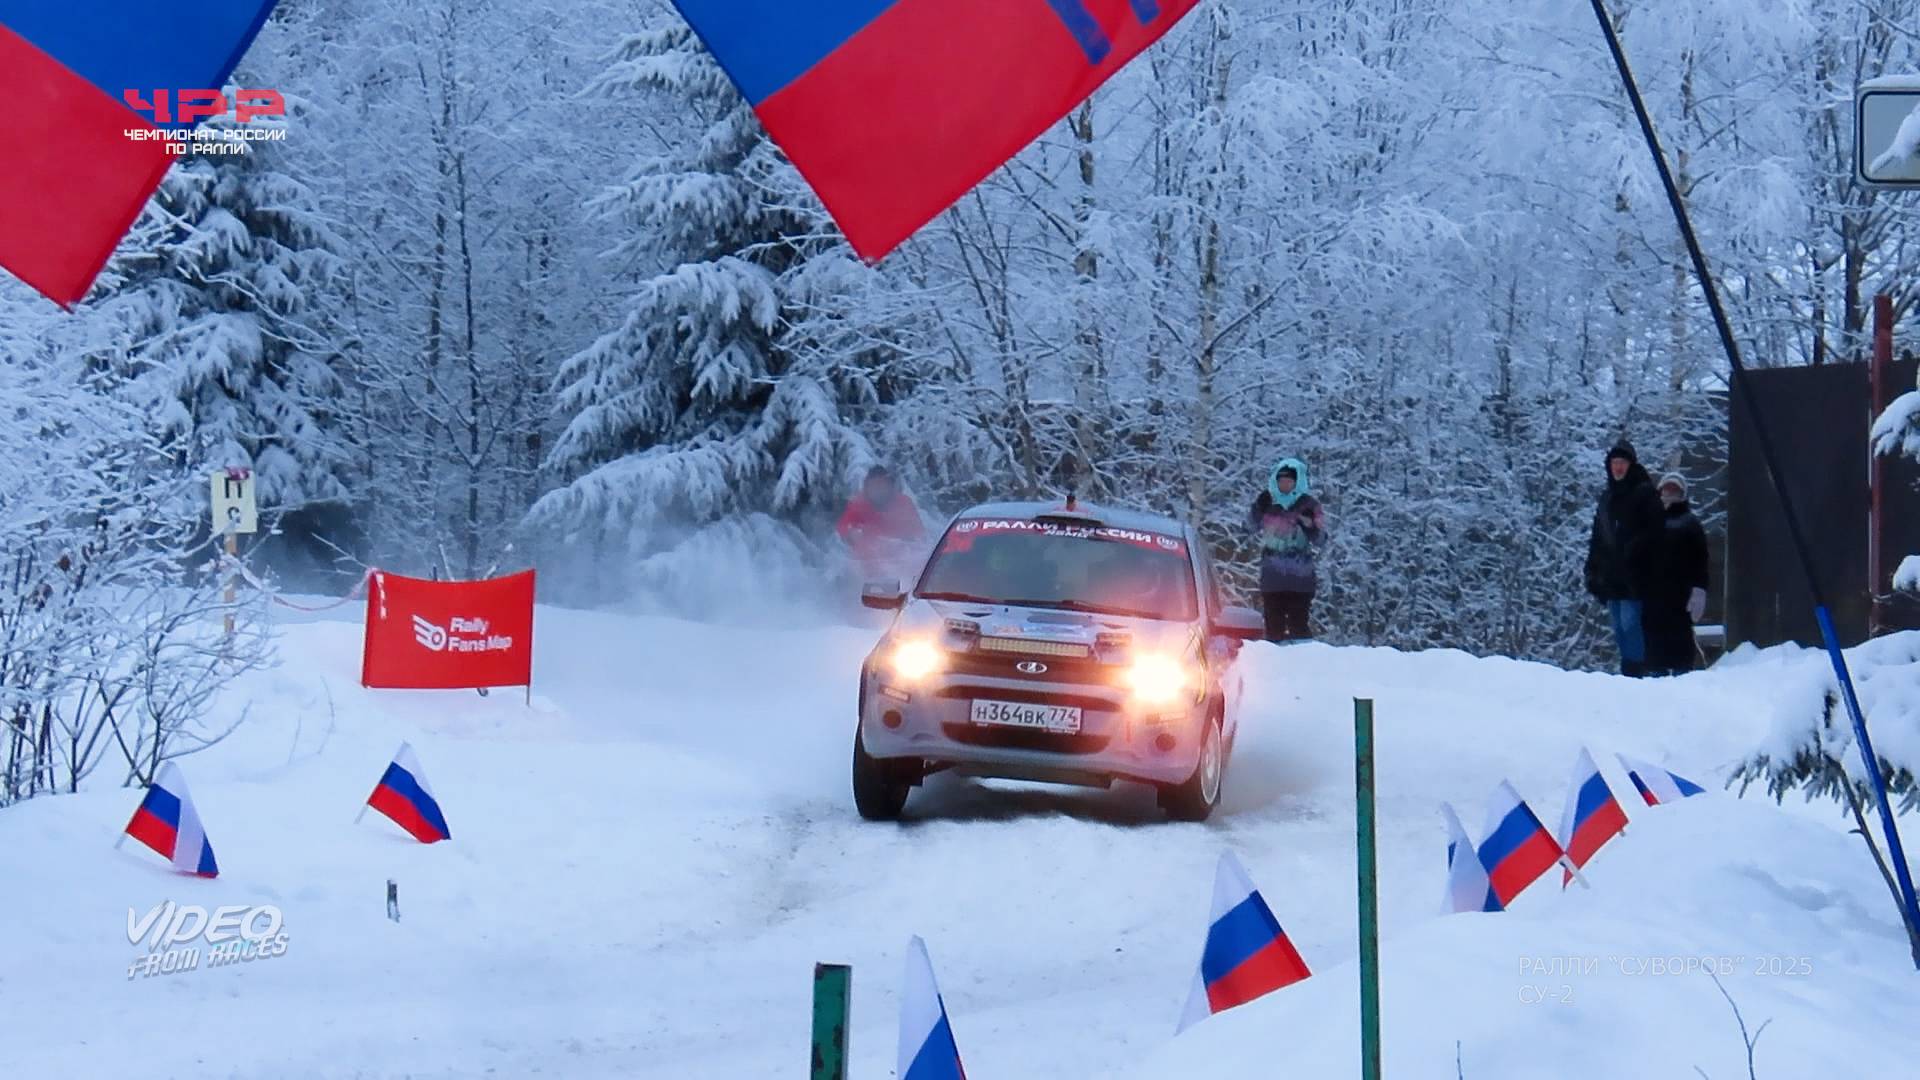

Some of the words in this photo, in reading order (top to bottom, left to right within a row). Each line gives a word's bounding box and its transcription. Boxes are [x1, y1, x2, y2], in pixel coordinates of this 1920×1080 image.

[982, 520, 1058, 531] РАЛЛИ
[1067, 525, 1152, 543] ССИИ
[450, 617, 489, 635] Rally
[448, 636, 486, 652] Fans
[1050, 708, 1079, 724] 774
